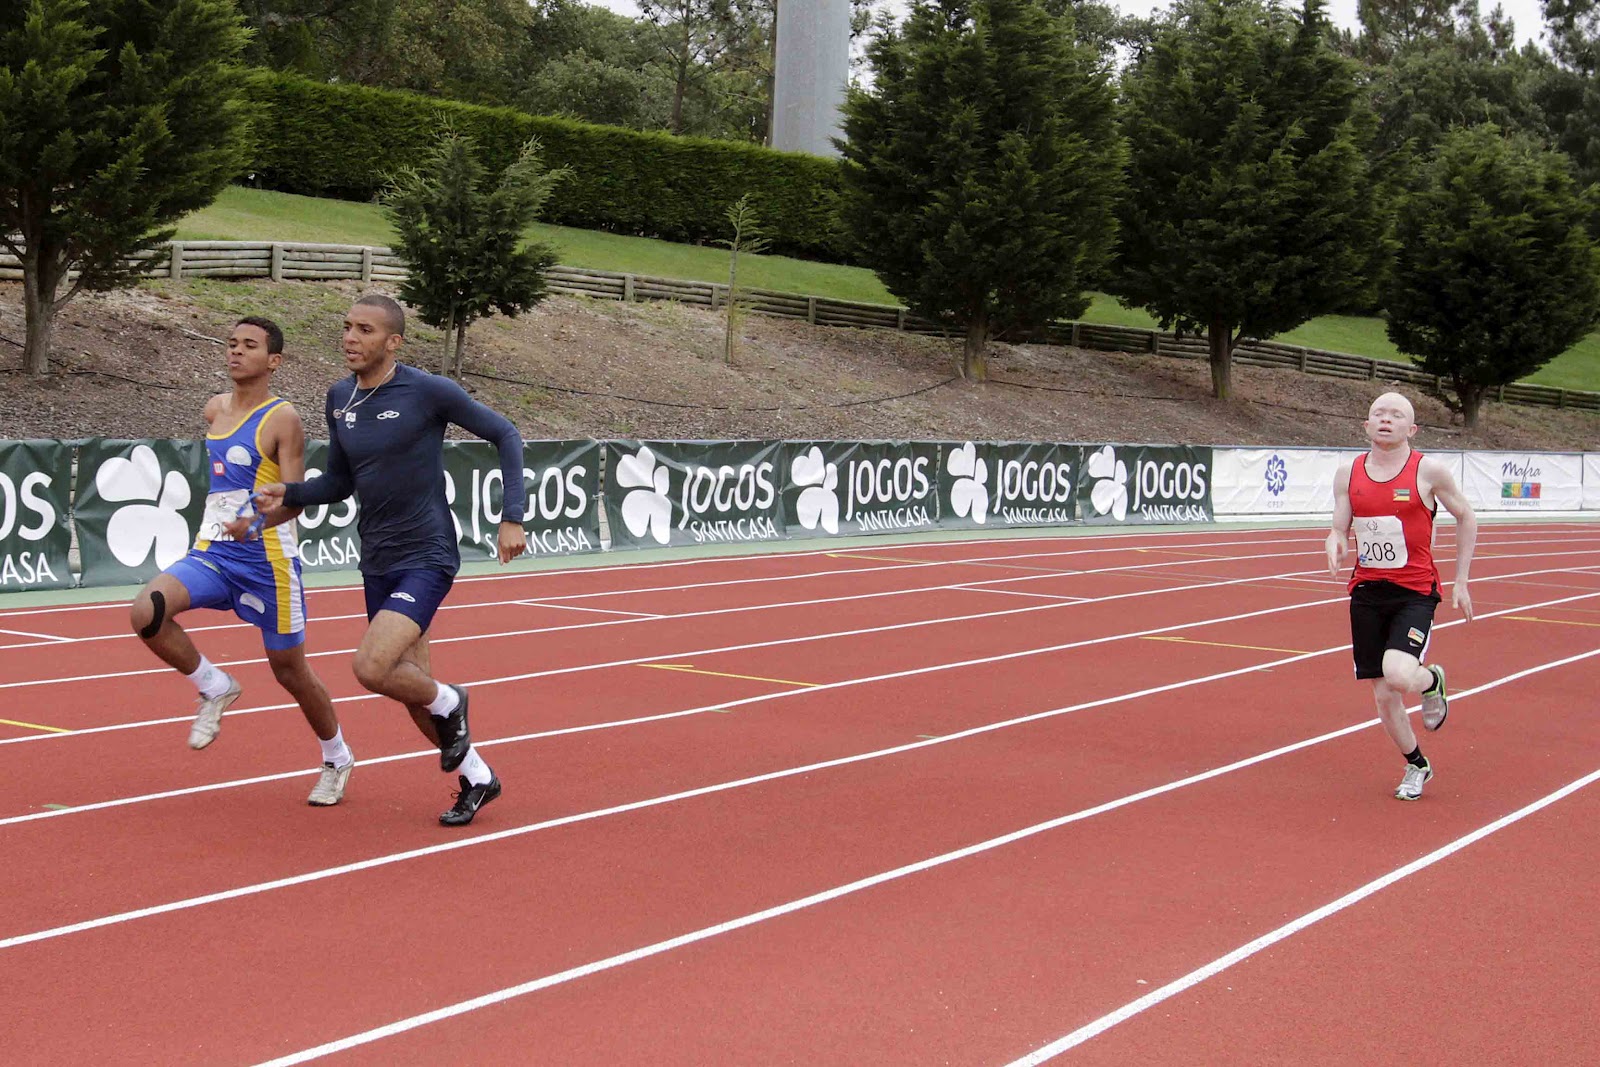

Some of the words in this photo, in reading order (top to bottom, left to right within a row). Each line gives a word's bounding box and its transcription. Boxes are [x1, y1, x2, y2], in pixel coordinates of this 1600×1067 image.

[993, 459, 1071, 514] JOGOS
[1132, 460, 1206, 512] JOGOS
[1501, 457, 1541, 489] Mafra
[678, 462, 775, 531] JOGOS
[845, 456, 929, 521] JOGOS
[855, 506, 931, 531] SANTACASA
[1002, 506, 1069, 524] SANTACASA
[1141, 503, 1209, 522] SANTACASA
[690, 516, 779, 542] SANTACASA
[1363, 541, 1396, 562] 208
